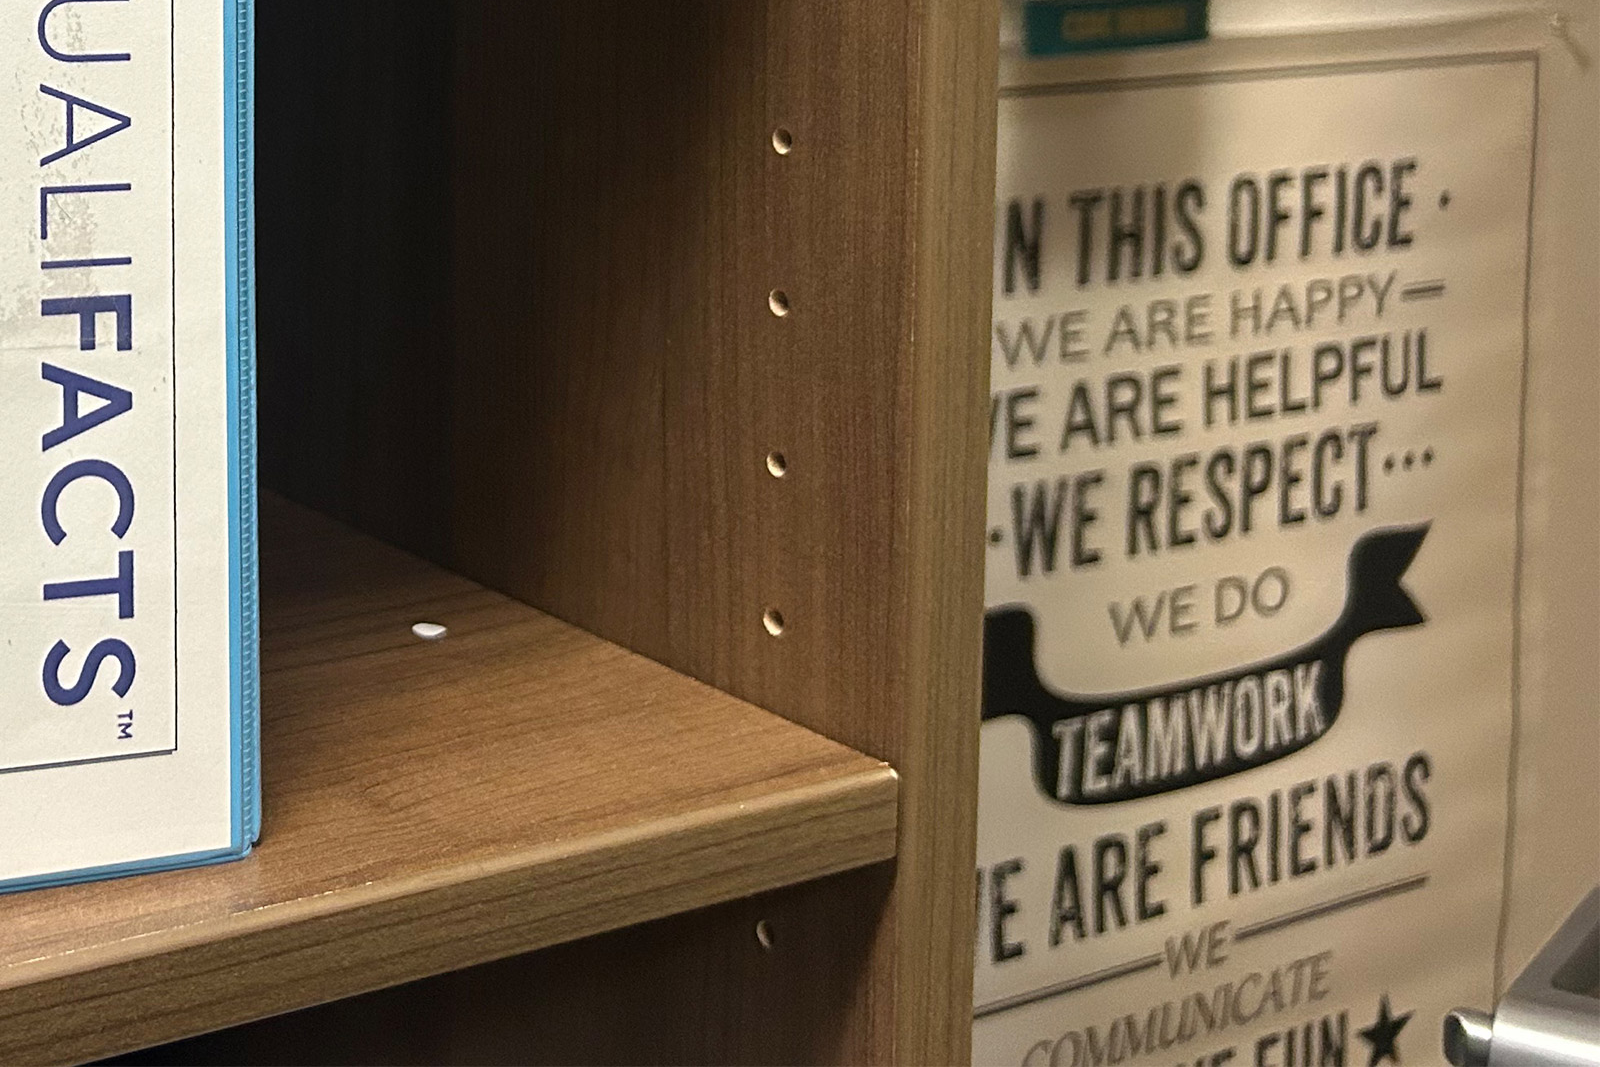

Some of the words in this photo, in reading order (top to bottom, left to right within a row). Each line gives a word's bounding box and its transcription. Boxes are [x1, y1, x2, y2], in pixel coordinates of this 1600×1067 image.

[1068, 177, 1207, 287] THIS
[1226, 157, 1417, 270] OFFICE
[995, 309, 1090, 367] WE
[1104, 293, 1212, 356] ARE
[1229, 270, 1398, 340] HAPPY
[990, 385, 1040, 461] E
[1060, 363, 1182, 453] ARE
[1202, 330, 1443, 430] HELPFUL
[1010, 469, 1104, 580] WE
[1108, 585, 1198, 646] WE
[1213, 565, 1292, 627] DO
[1051, 660, 1327, 803] TEAMWORK
[977, 856, 1025, 966] E
[1047, 820, 1168, 946] ARE
[1189, 750, 1433, 908] FRIENDS
[1165, 918, 1230, 979] WE
